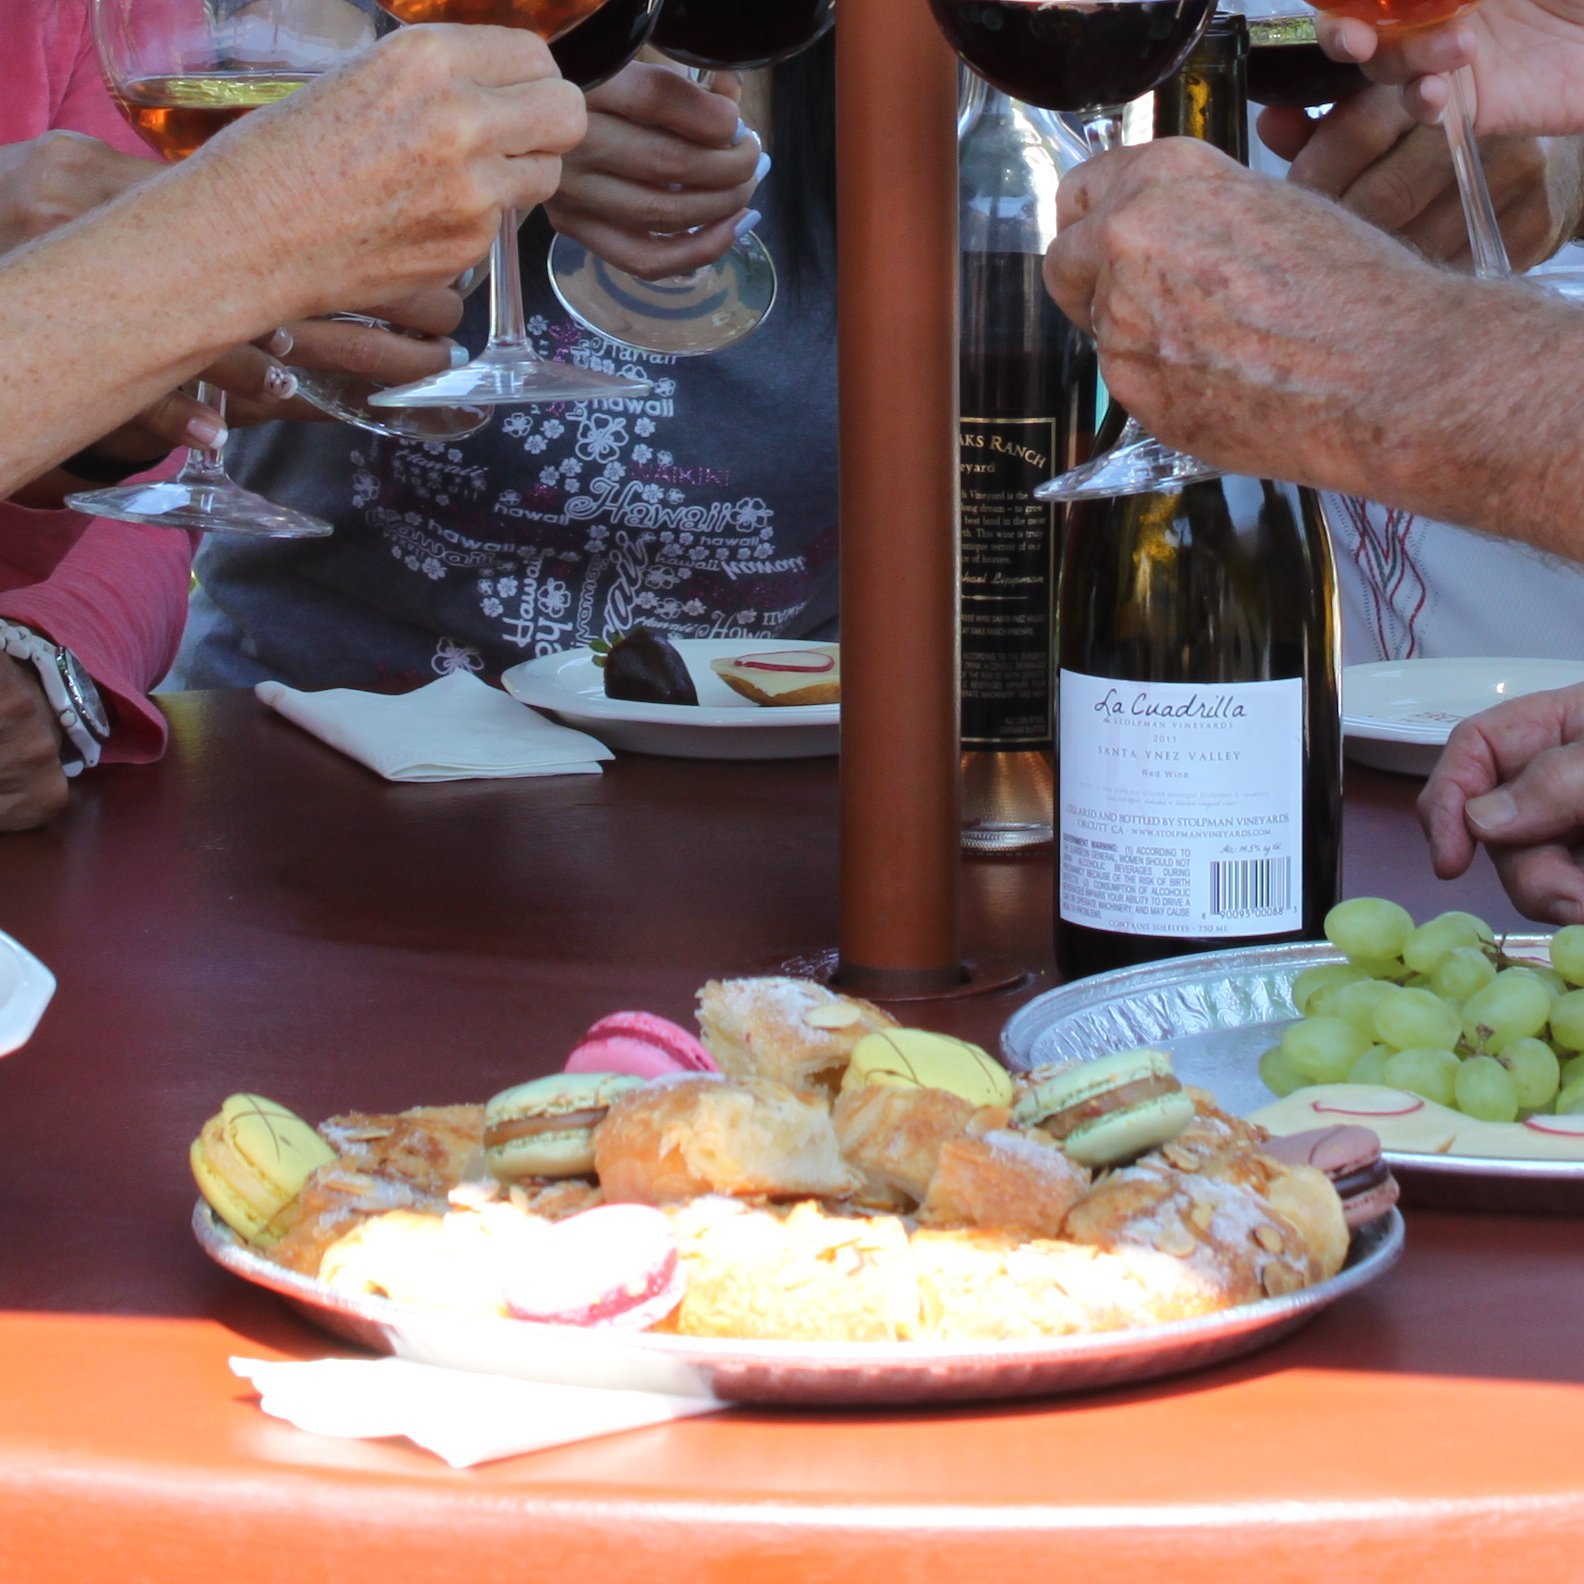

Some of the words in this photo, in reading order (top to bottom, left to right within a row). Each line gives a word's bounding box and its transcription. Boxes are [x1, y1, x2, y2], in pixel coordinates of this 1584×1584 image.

[989, 436, 1047, 469] RANCH
[565, 477, 733, 533] Hawaii
[493, 502, 570, 526] hawaii
[428, 518, 516, 553] hawaii
[700, 535, 759, 547] hawaii
[655, 553, 720, 571] hawaii
[1094, 688, 1124, 717] La
[1130, 692, 1247, 719] Cuadrilla
[1113, 719, 1167, 729] STOLPMAN
[1171, 722, 1234, 730] VINEYARDS
[1153, 735, 1177, 743] 2011
[1097, 745, 1137, 759] SANTA
[1145, 750, 1180, 761] YNEZ
[1188, 751, 1241, 761] VALLEY
[1141, 768, 1160, 778] Red
[1165, 770, 1189, 779] Wine
[1097, 811, 1117, 822] AND
[1118, 814, 1160, 825] BOTTLED
[1162, 817, 1174, 826] BY
[1177, 817, 1234, 827] STOLPMAN
[1236, 812, 1289, 826] VINEYARDS
[1111, 824, 1124, 834] CA
[1136, 847, 1177, 857] ACCORDING
[1180, 849, 1191, 857] TO
[1146, 857, 1174, 866] SHOULD
[1175, 858, 1191, 867] NOT
[1114, 863, 1153, 876] BEVERAGES
[1163, 867, 1191, 877] DURING
[1156, 877, 1166, 886] OF
[1169, 878, 1191, 887] BIRTH
[1151, 886, 1191, 897] ALCOHOLIC
[1162, 897, 1183, 907] DRIVE
[1184, 899, 1191, 907] A
[1135, 905, 1149, 915] AND
[1149, 906, 1165, 916] MAY
[1166, 907, 1191, 917] CAUSE
[1107, 920, 1150, 931] CONTAINS
[1153, 923, 1190, 932] SULFITES
